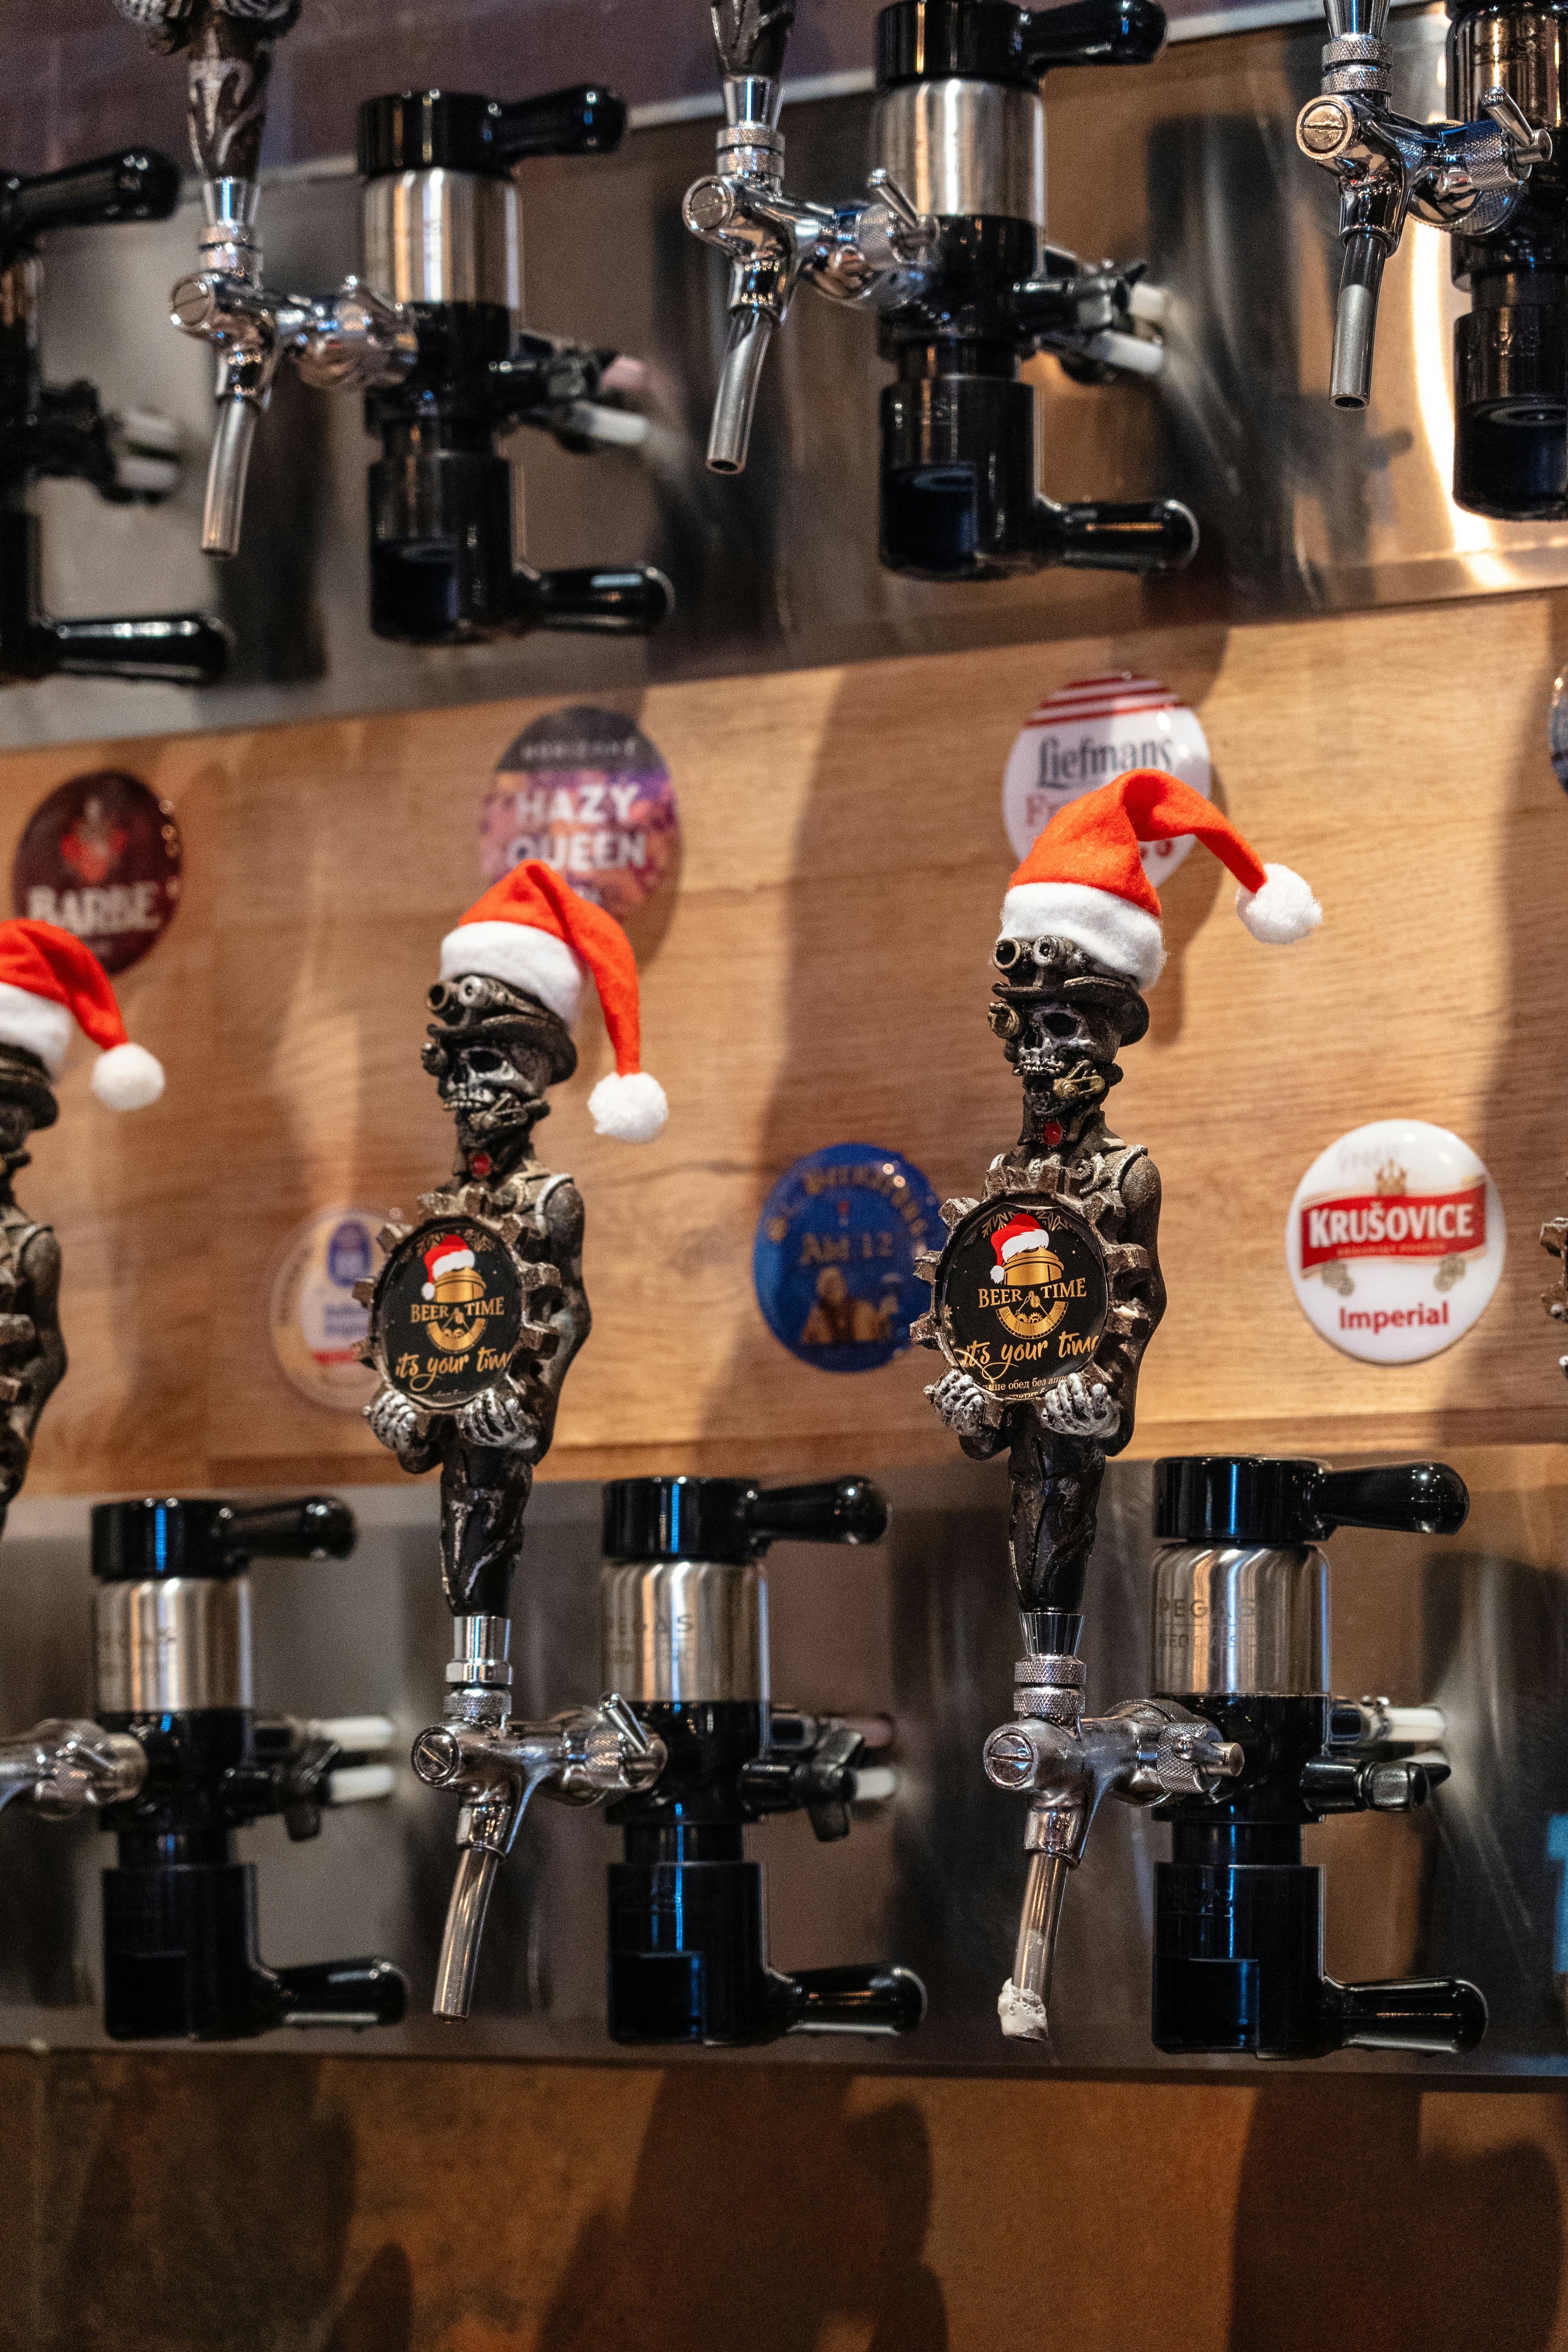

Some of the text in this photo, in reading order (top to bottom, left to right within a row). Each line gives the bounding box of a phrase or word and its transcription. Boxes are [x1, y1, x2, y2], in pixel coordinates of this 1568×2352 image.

[1040, 737, 1173, 788] Liefmans
[515, 782, 641, 824] HAZY
[506, 830, 646, 872] QUEEN
[1308, 1201, 1474, 1249] KRUŠOVICE
[410, 1296, 505, 1323] BEER TIME
[978, 1277, 1087, 1308] BEER TIME
[1339, 1300, 1449, 1334] Imperial
[409, 1354, 470, 1392] your
[964, 1340, 991, 1368] it's
[982, 1339, 1048, 1380] your
[1008, 1379, 1029, 1390] обед
[1032, 1377, 1046, 1387] без
